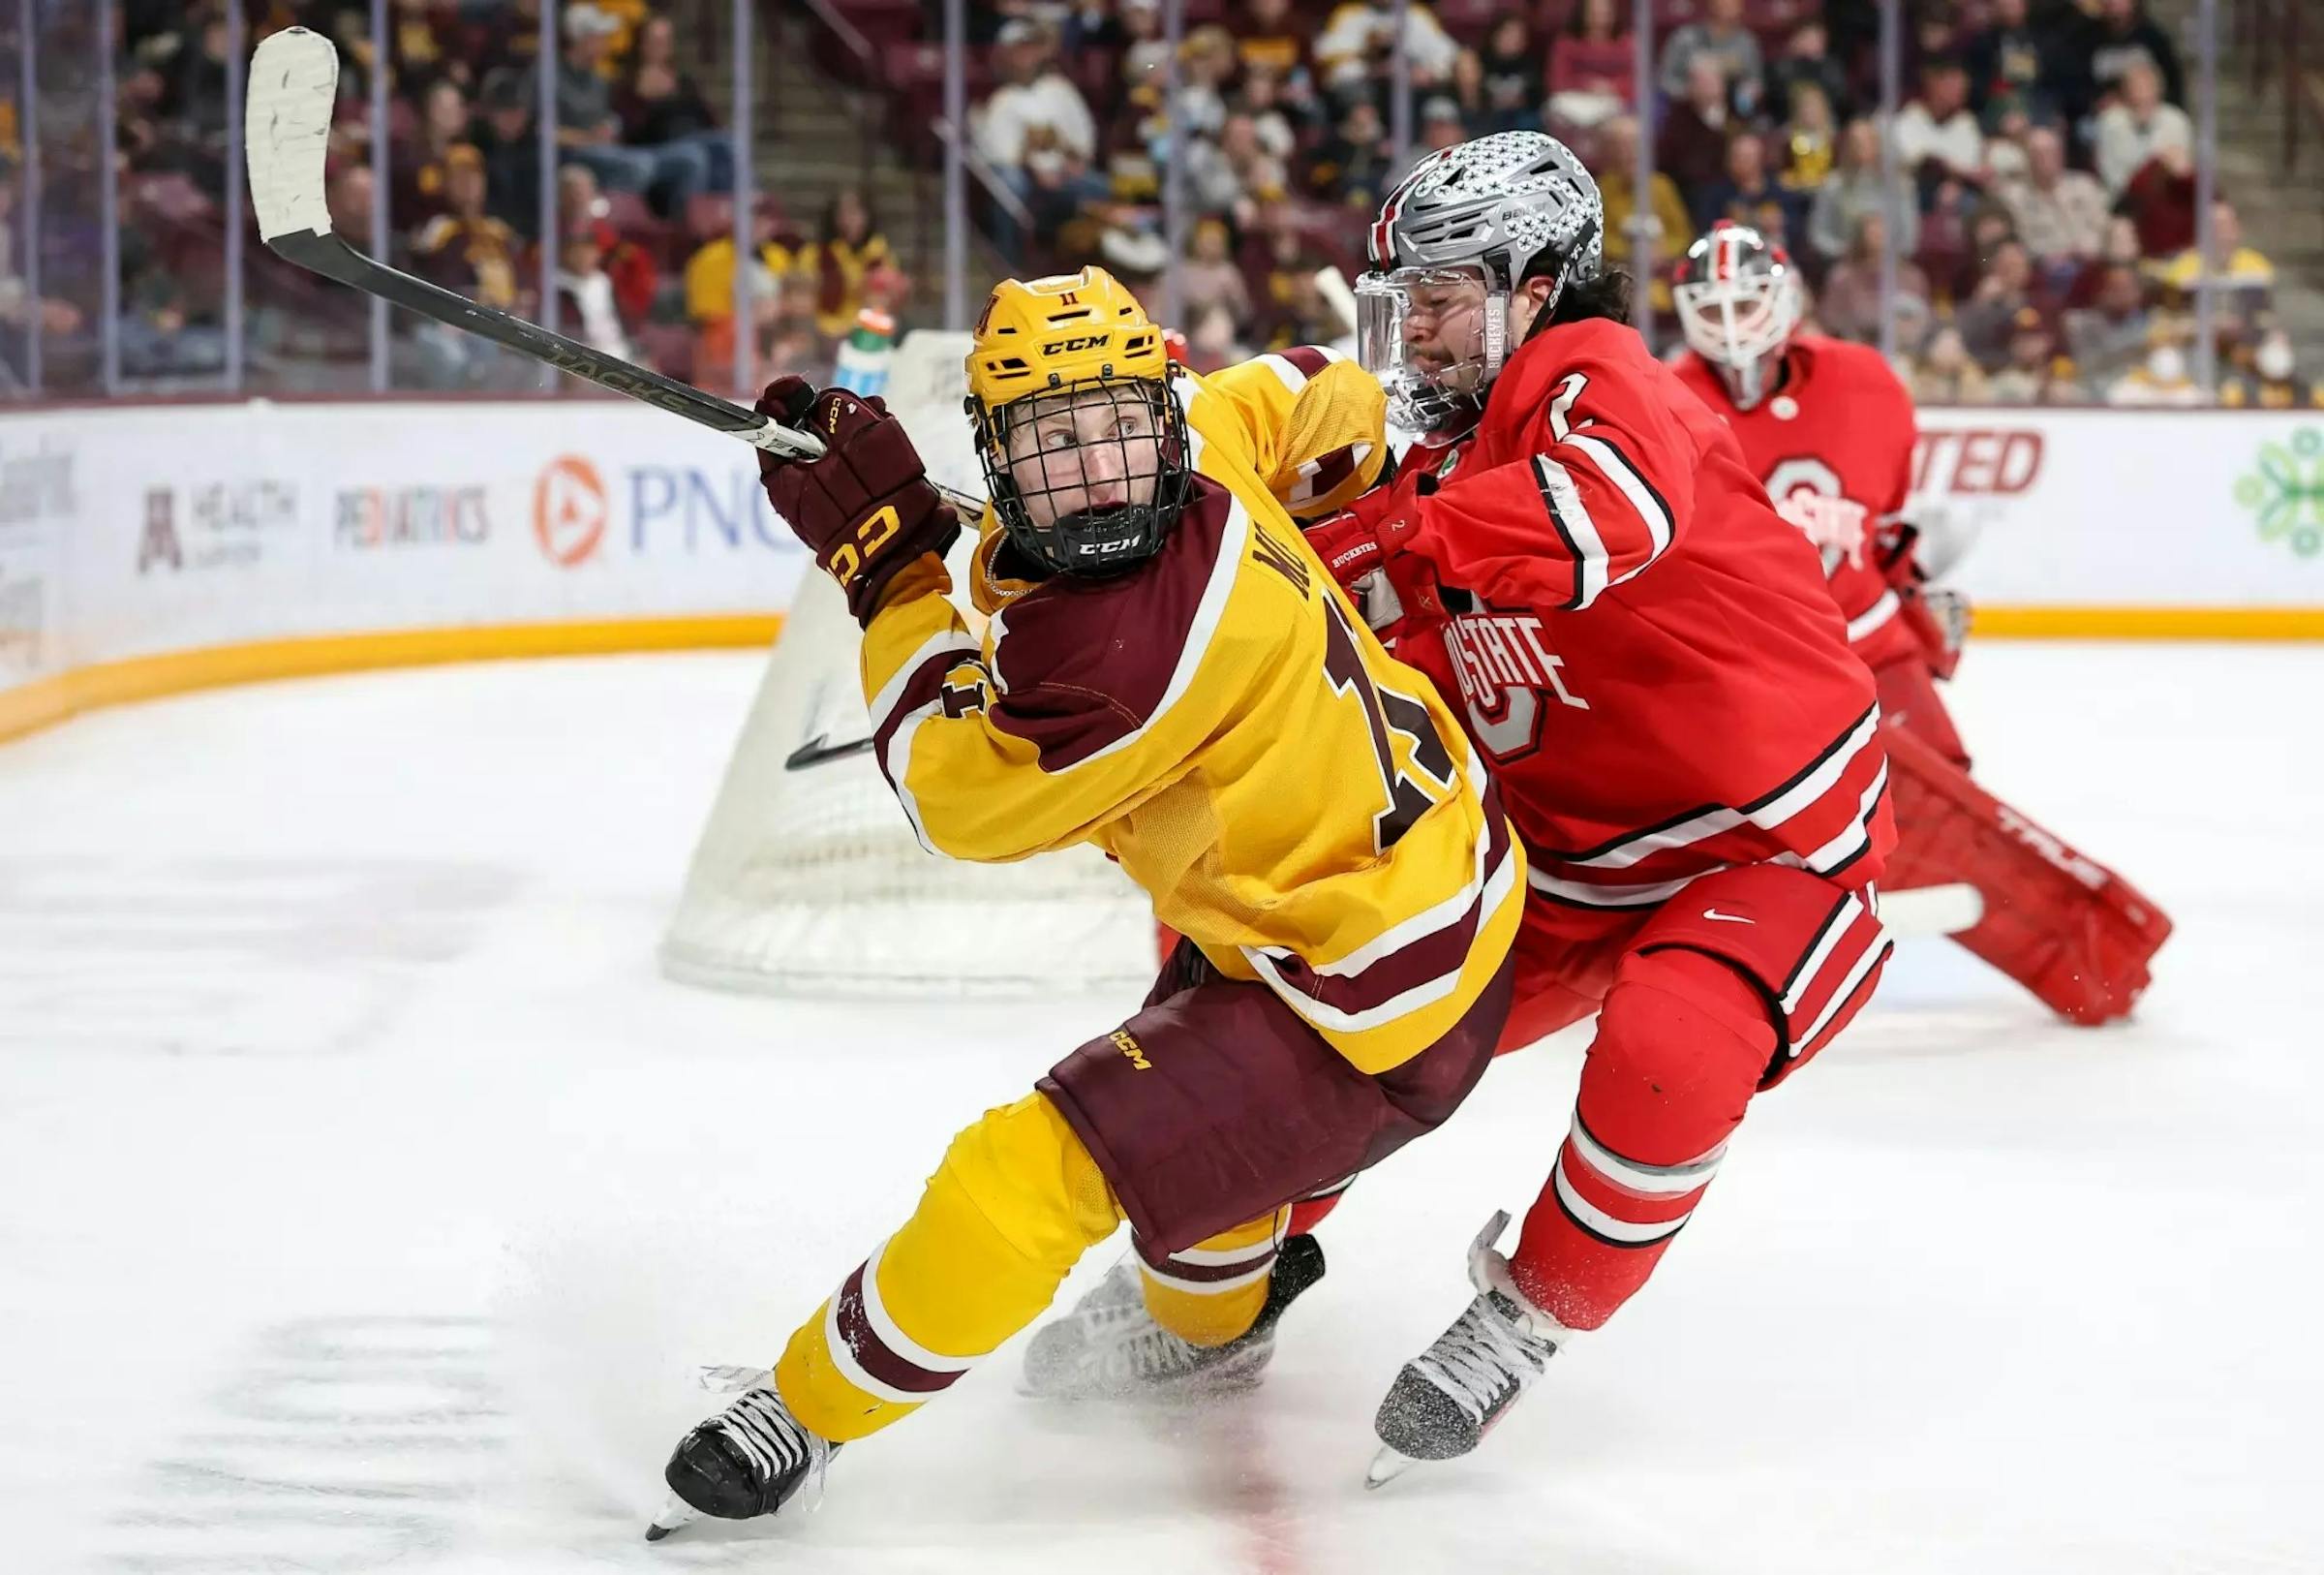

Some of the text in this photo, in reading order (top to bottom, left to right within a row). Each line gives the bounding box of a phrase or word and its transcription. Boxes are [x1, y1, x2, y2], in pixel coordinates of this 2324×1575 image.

[1059, 293, 1079, 306] 11
[1043, 335, 1108, 356] CCM
[1487, 309, 1502, 369] BUCKEYES
[829, 397, 841, 434] CCM
[1913, 429, 2043, 493] TED
[1080, 535, 1141, 554] CCM
[1332, 541, 1377, 569] BUCKEYES
[1110, 1031, 1152, 1070] CCM
